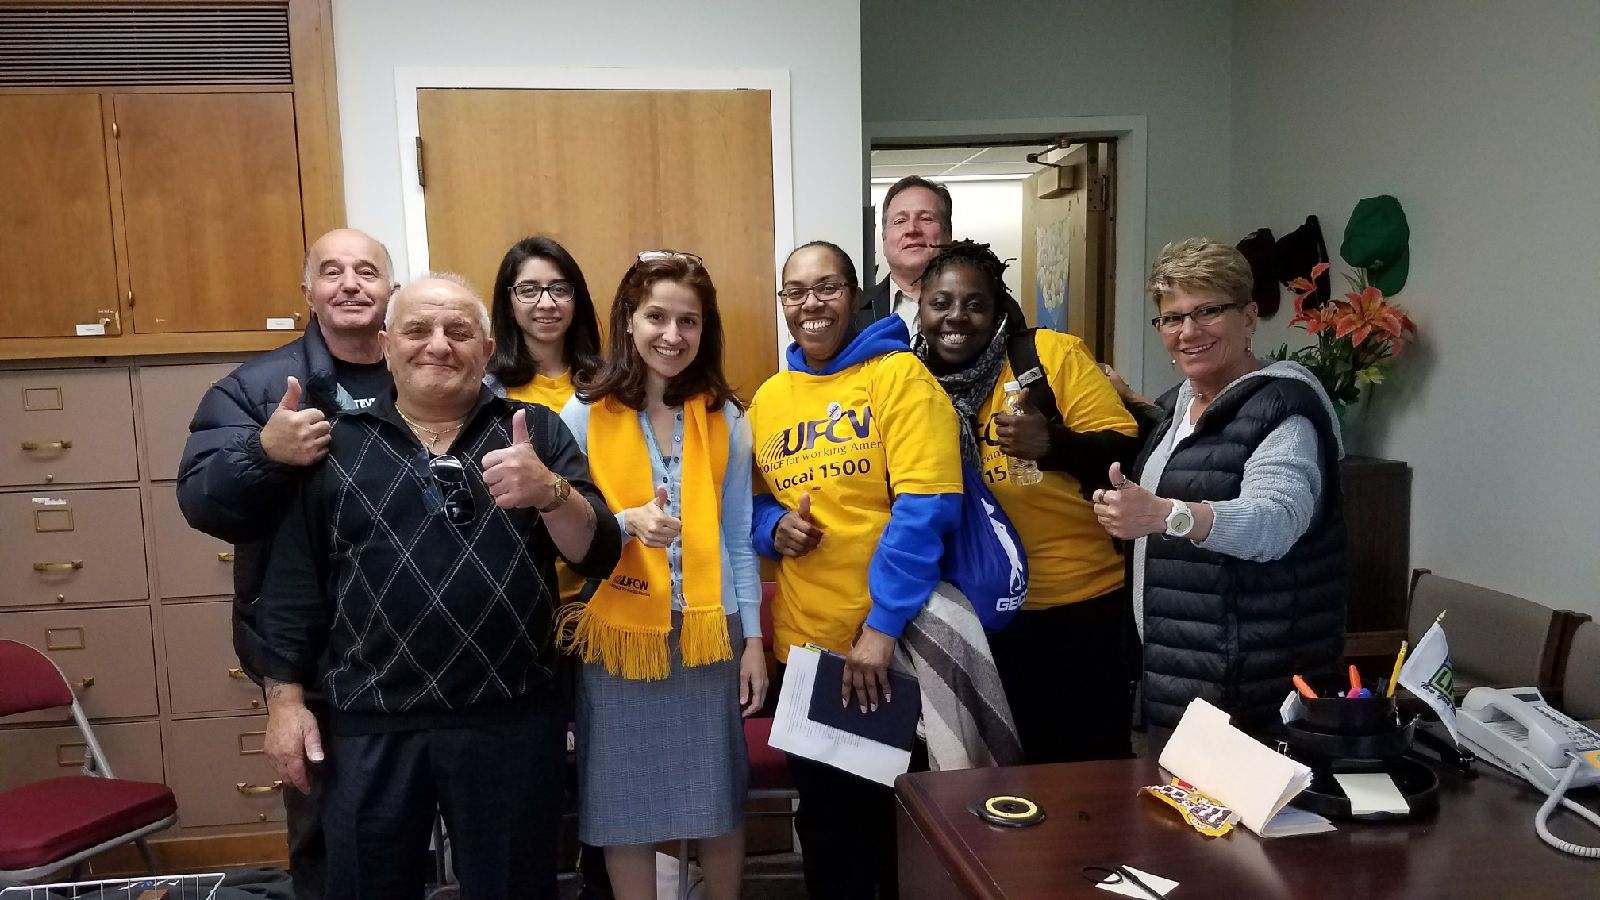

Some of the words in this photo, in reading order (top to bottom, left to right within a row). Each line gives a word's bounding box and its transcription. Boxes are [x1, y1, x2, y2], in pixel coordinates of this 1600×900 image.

[801, 445, 847, 461] working
[851, 440, 883, 451] Amer
[774, 466, 814, 492] Local
[819, 458, 871, 479] 1500
[984, 466, 1007, 483] 15
[620, 576, 649, 590] UFCW
